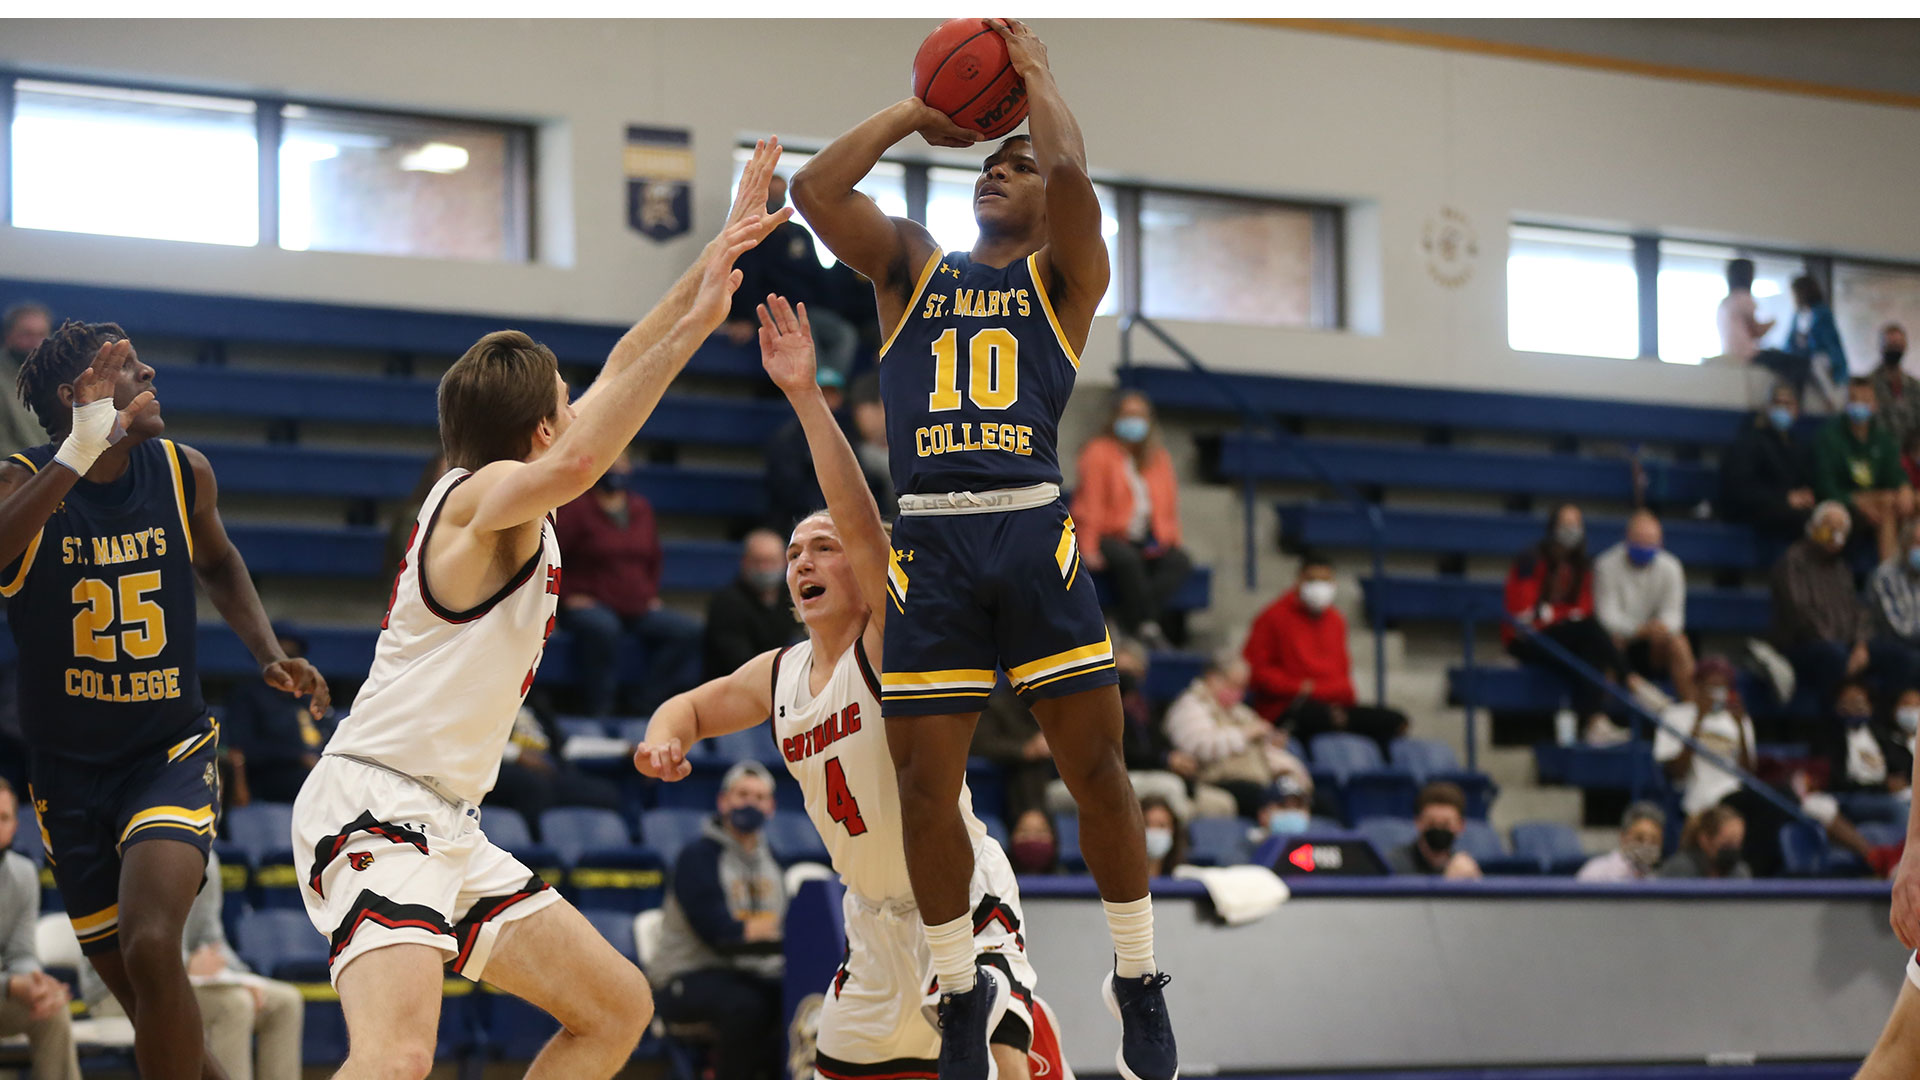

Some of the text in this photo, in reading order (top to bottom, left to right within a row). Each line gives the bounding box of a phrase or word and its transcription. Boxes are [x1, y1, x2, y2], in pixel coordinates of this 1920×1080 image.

[974, 80, 1027, 129] NCAA
[953, 288, 1031, 318] MARY'S
[929, 327, 1018, 412] 10
[915, 422, 1033, 457] COLLEGE
[62, 527, 167, 566] ST. MARY'S
[72, 569, 167, 662] 25
[65, 667, 181, 702] COLLEGE
[825, 756, 868, 837] 4
